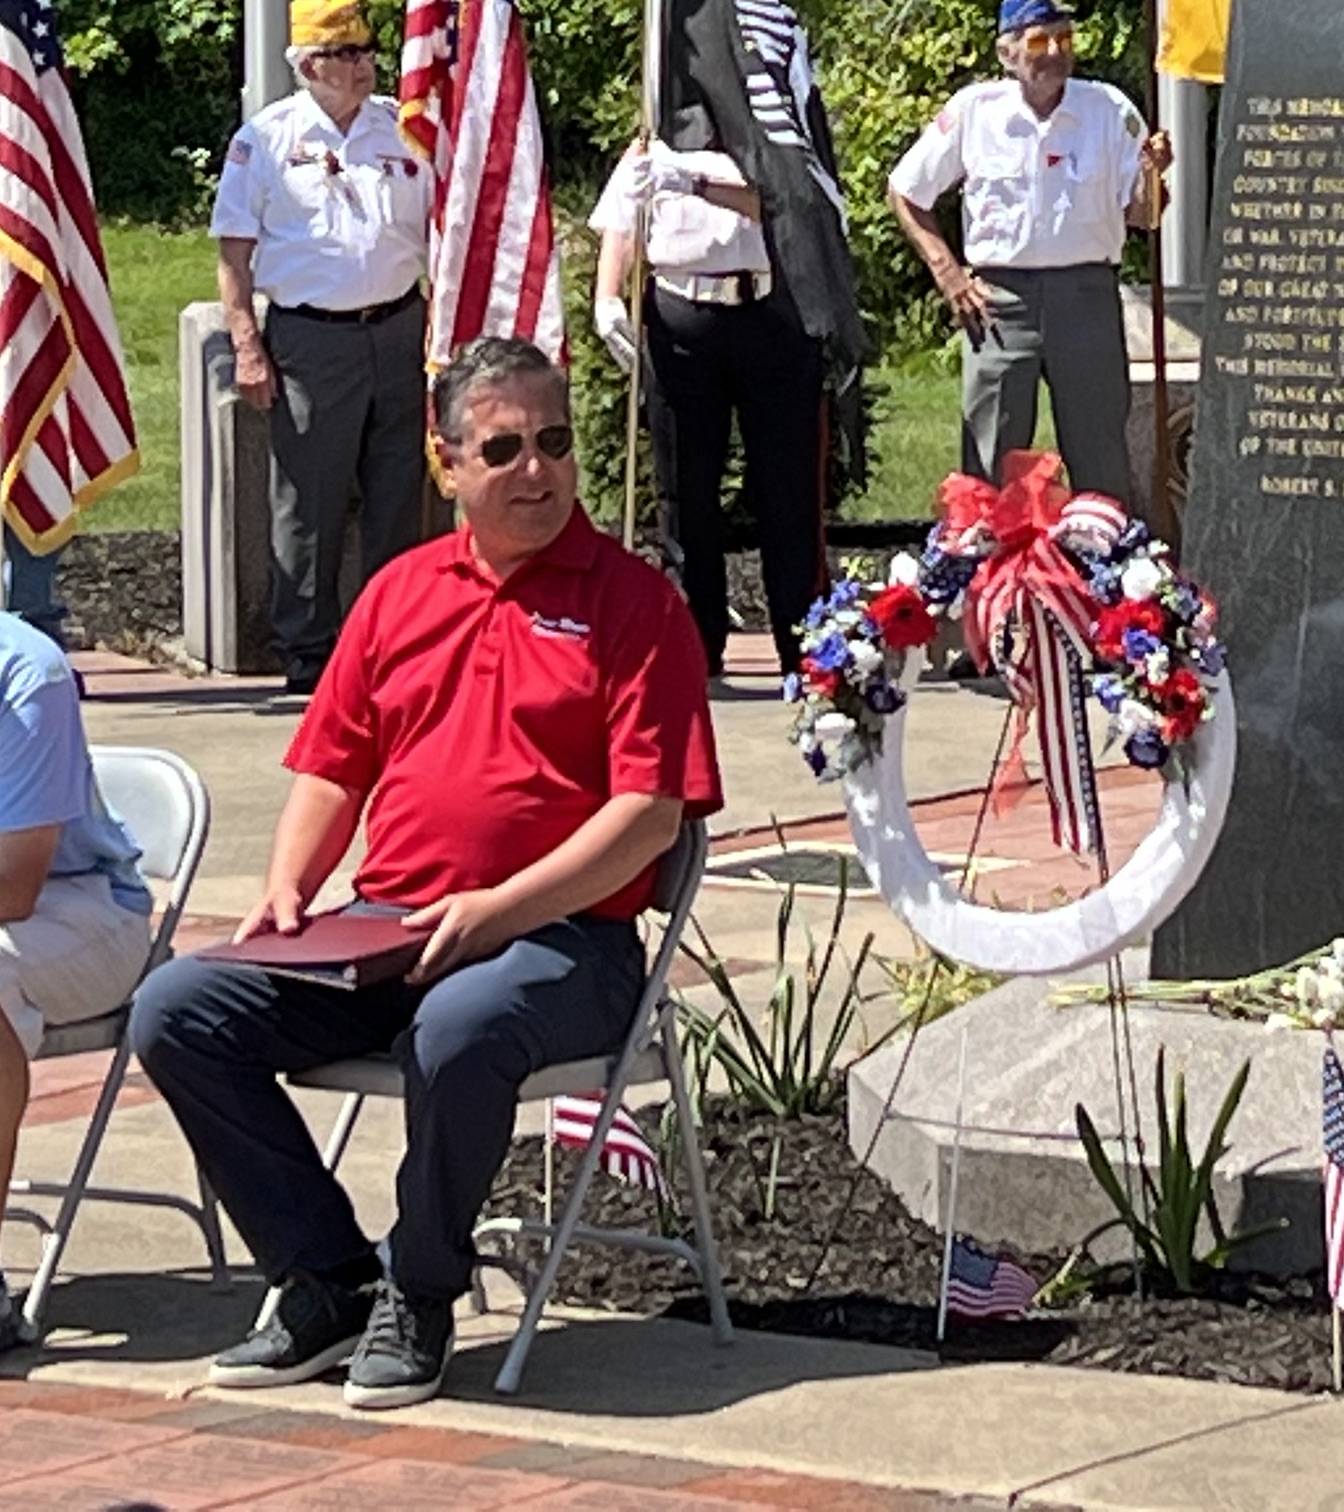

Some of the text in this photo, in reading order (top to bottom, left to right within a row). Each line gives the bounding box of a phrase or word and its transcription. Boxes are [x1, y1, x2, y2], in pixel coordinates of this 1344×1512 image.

[1307, 150, 1327, 168] OF
[1231, 201, 1302, 219] WHETHER
[1309, 203, 1326, 219] IN
[1223, 227, 1243, 244] OR
[1221, 253, 1254, 271] AND
[1259, 253, 1326, 274] PROTECT
[1218, 278, 1238, 296] OF
[1243, 279, 1274, 298] OUR
[1280, 279, 1329, 299] GREAT
[1225, 305, 1258, 323] AND
[1244, 333, 1296, 351] STOOD
[1301, 333, 1332, 352] THE
[1215, 355, 1248, 375] THIS
[1254, 358, 1335, 377] MEMORIAL
[1254, 383, 1316, 403] THANKS
[1248, 410, 1330, 431] VETERANS
[1239, 435, 1261, 456] OF
[1266, 438, 1297, 456] THE
[1260, 474, 1319, 495] ROBERT
